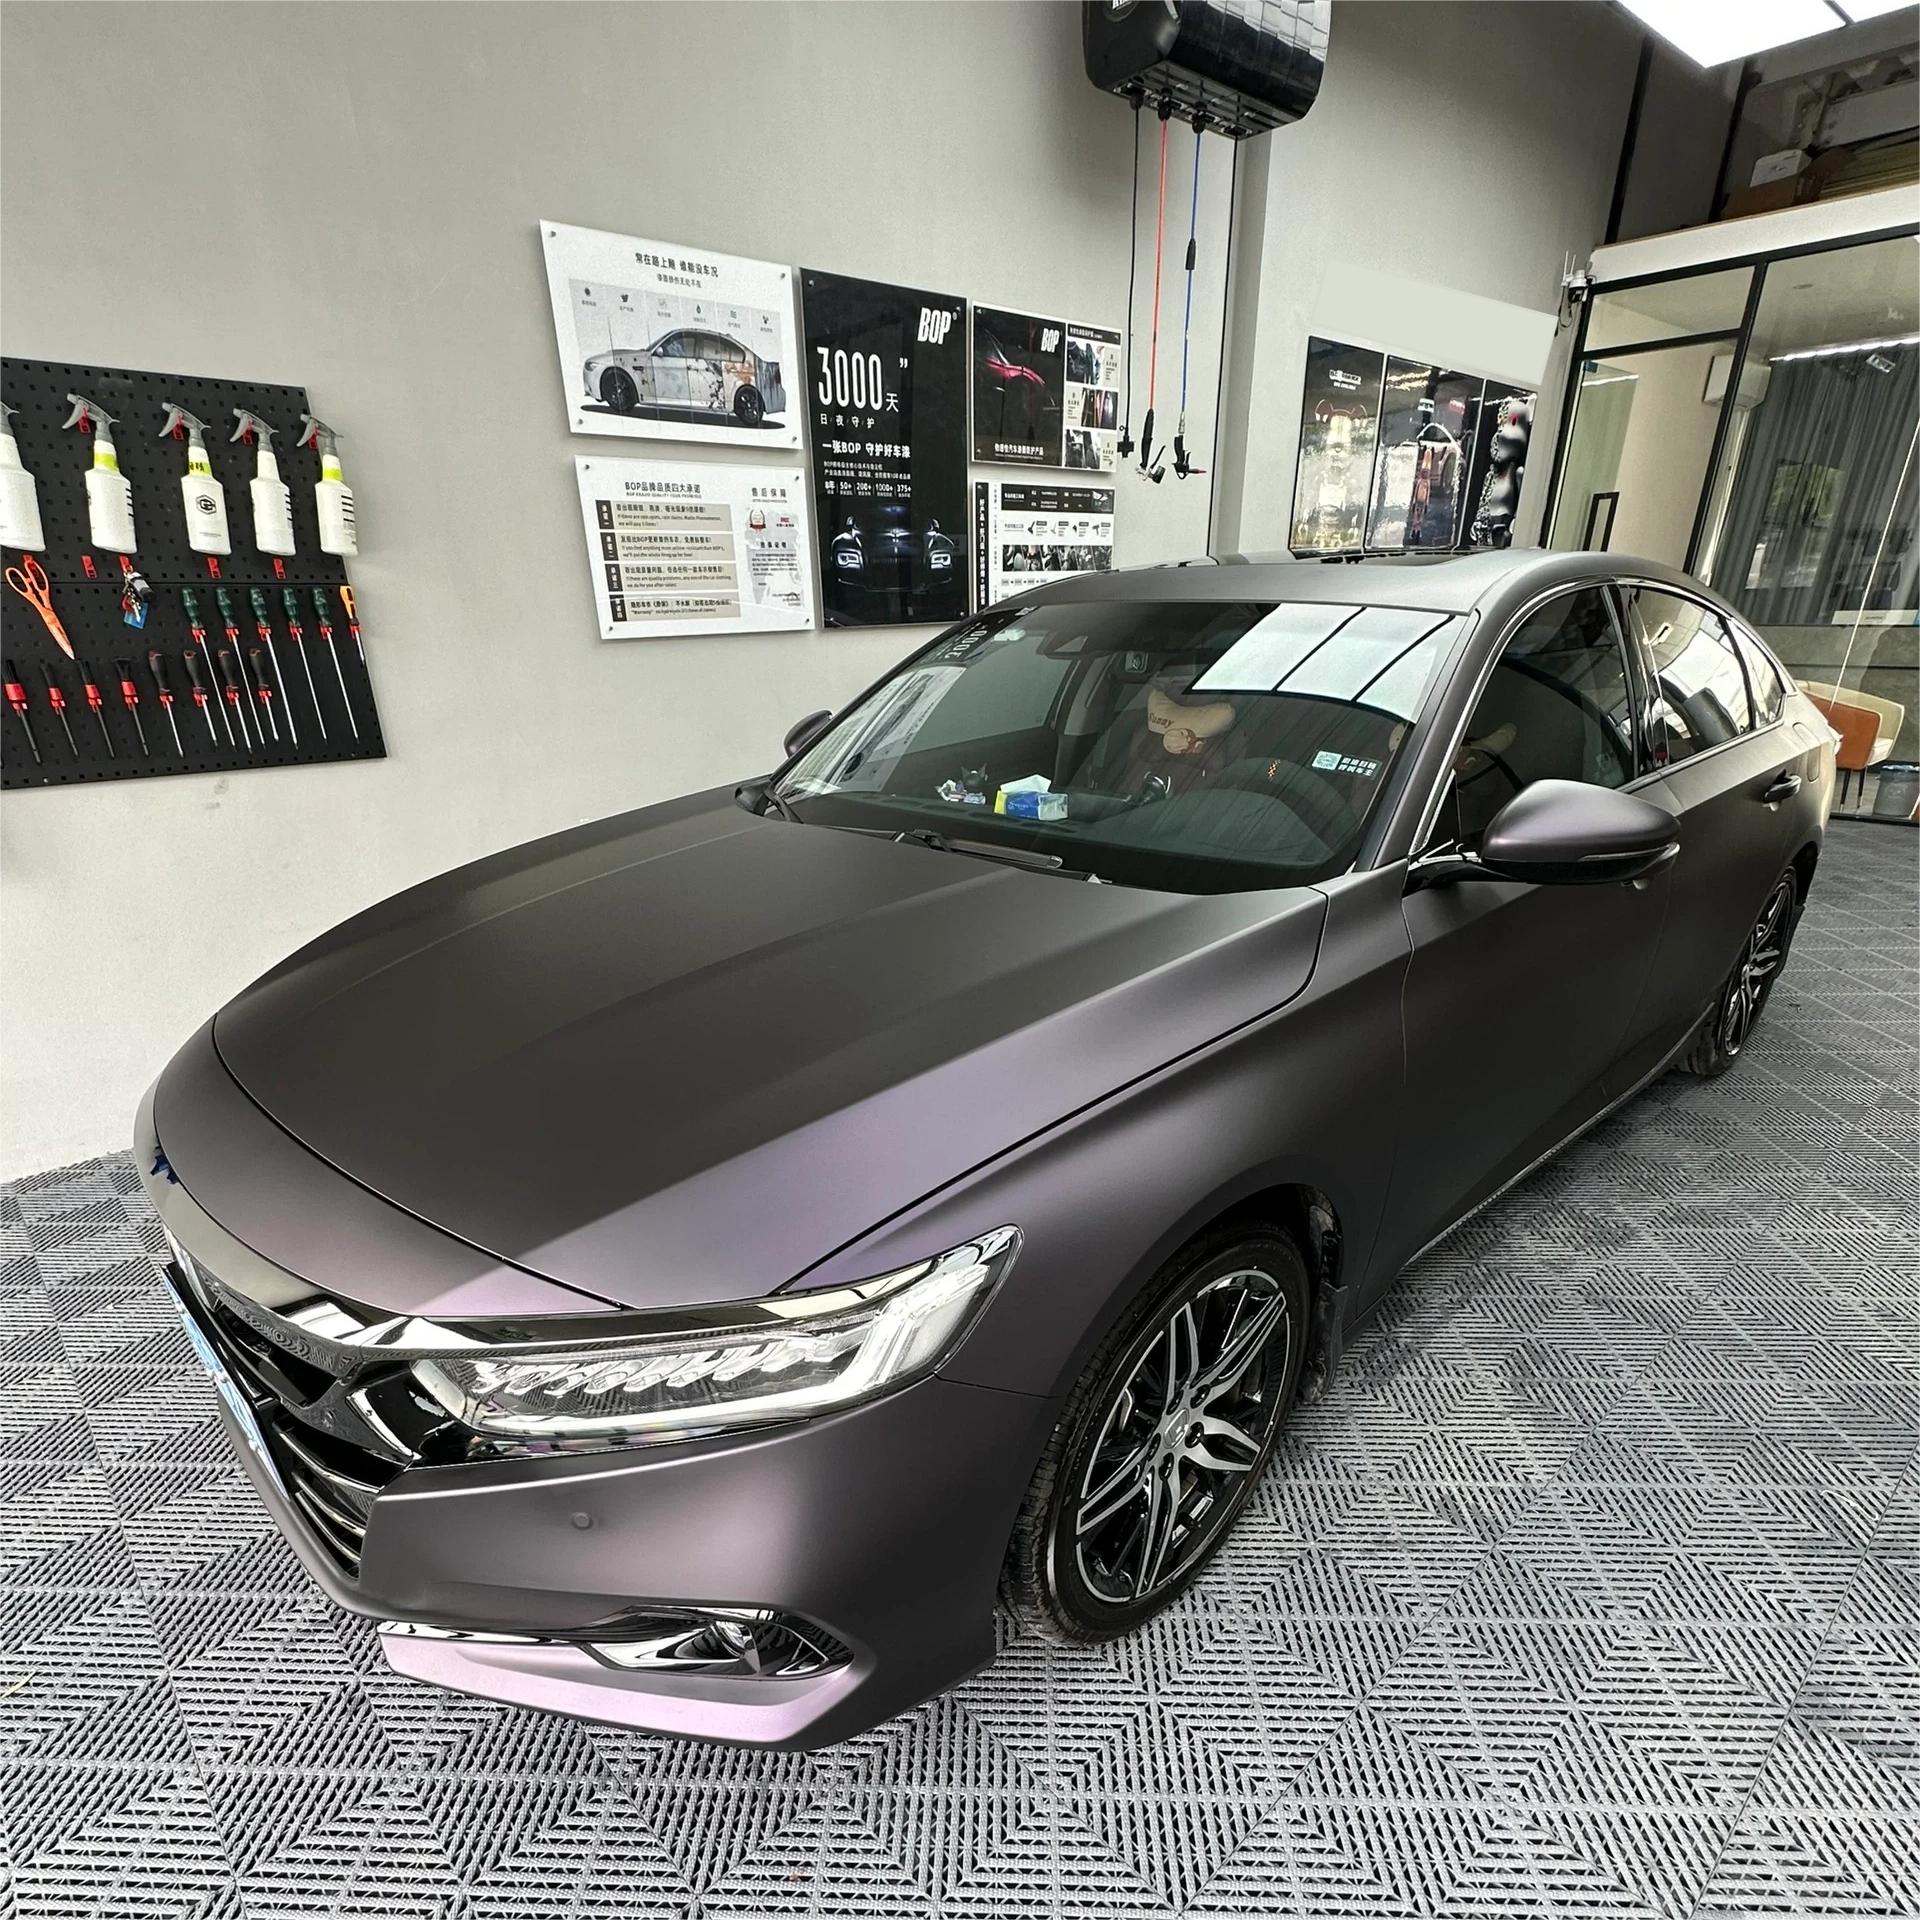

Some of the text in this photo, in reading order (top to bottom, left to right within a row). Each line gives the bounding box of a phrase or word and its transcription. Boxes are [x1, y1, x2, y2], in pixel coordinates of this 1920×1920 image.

[917, 307, 952, 345] BOP
[1040, 327, 1060, 353] BOP
[816, 346, 899, 413] 3000 天
[822, 439, 911, 458] 一张BOP 守护好车漆
[856, 482, 872, 491] 200+
[875, 483, 893, 492] 1000+
[896, 484, 912, 493] 375+
